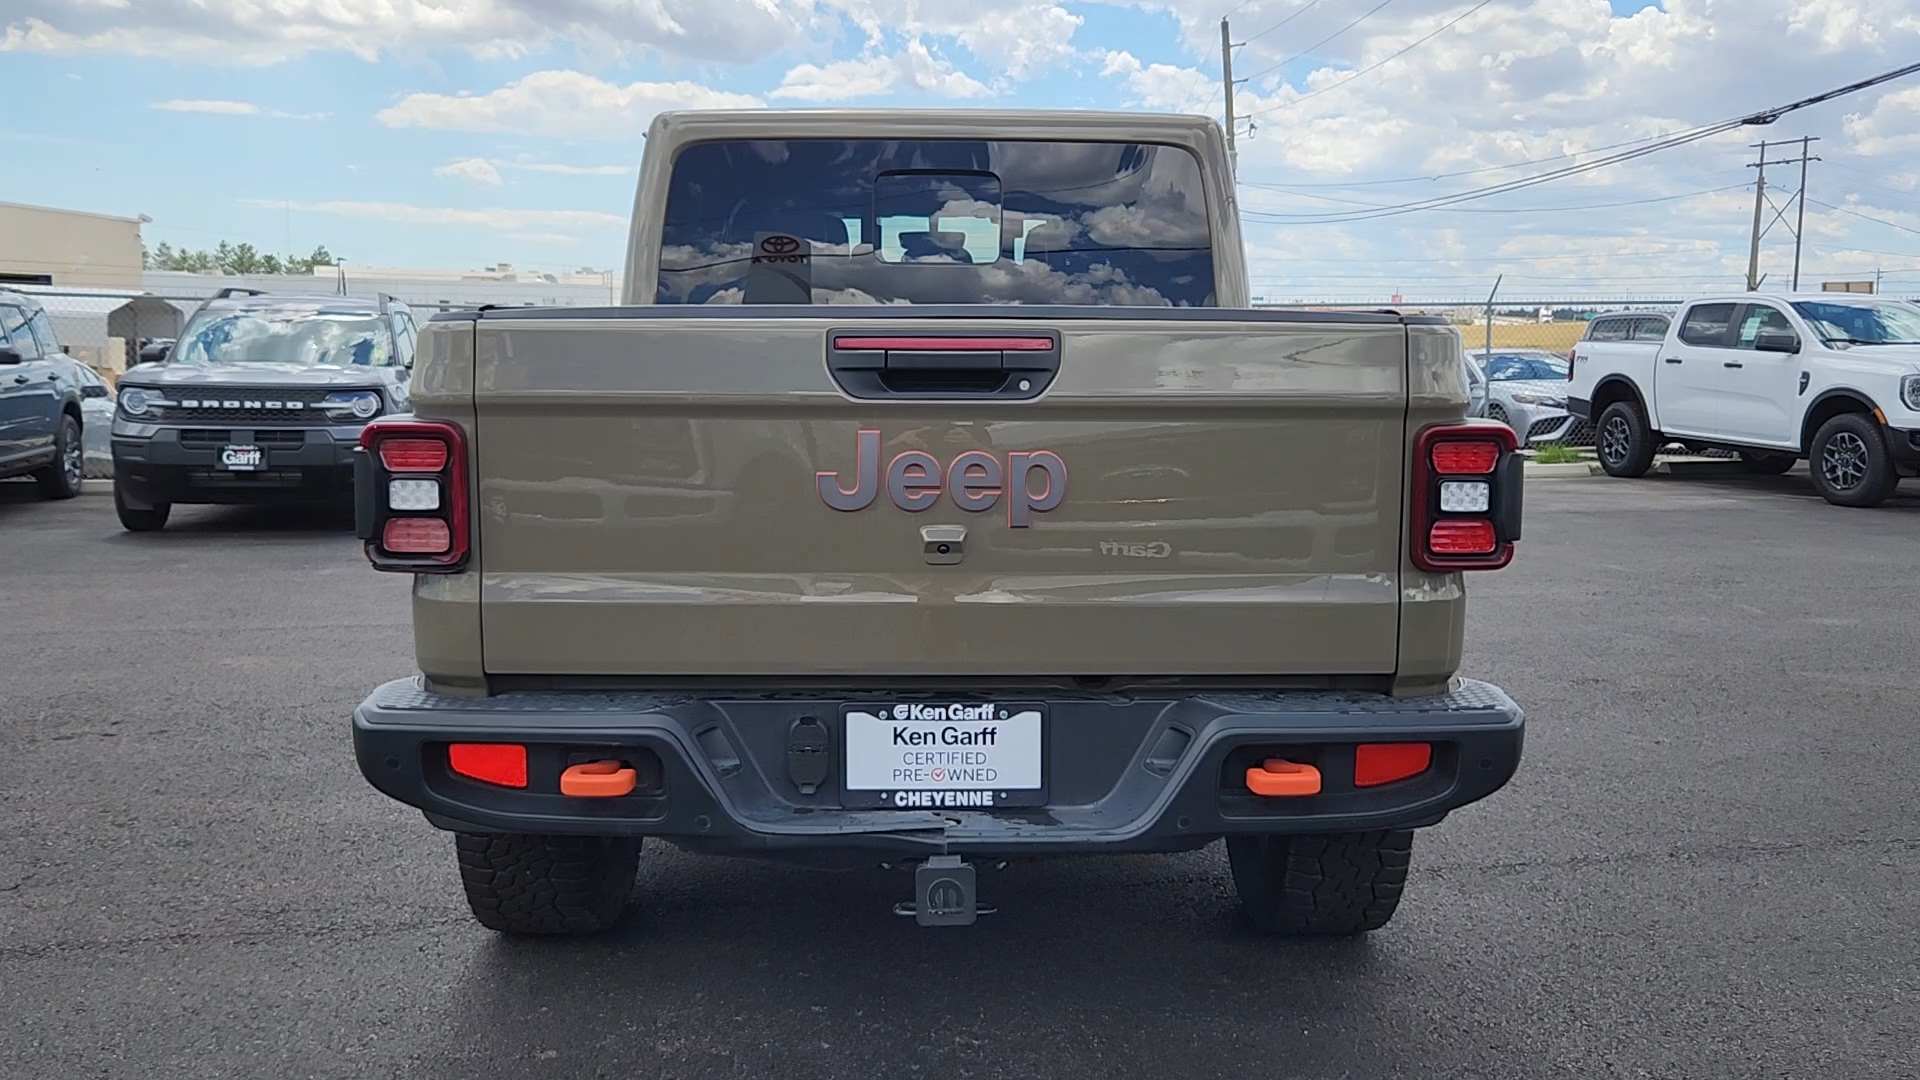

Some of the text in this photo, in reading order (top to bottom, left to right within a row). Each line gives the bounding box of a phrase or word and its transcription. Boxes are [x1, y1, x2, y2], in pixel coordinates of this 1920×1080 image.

[181, 400, 304, 409] BRONCO
[222, 449, 261, 465] Garff
[815, 429, 1068, 529] Jeep
[910, 703, 995, 720] Ken Garff
[893, 726, 997, 746] Ken Garff
[903, 752, 987, 766] CERTIFIED
[894, 790, 994, 807] CHEYENNE
